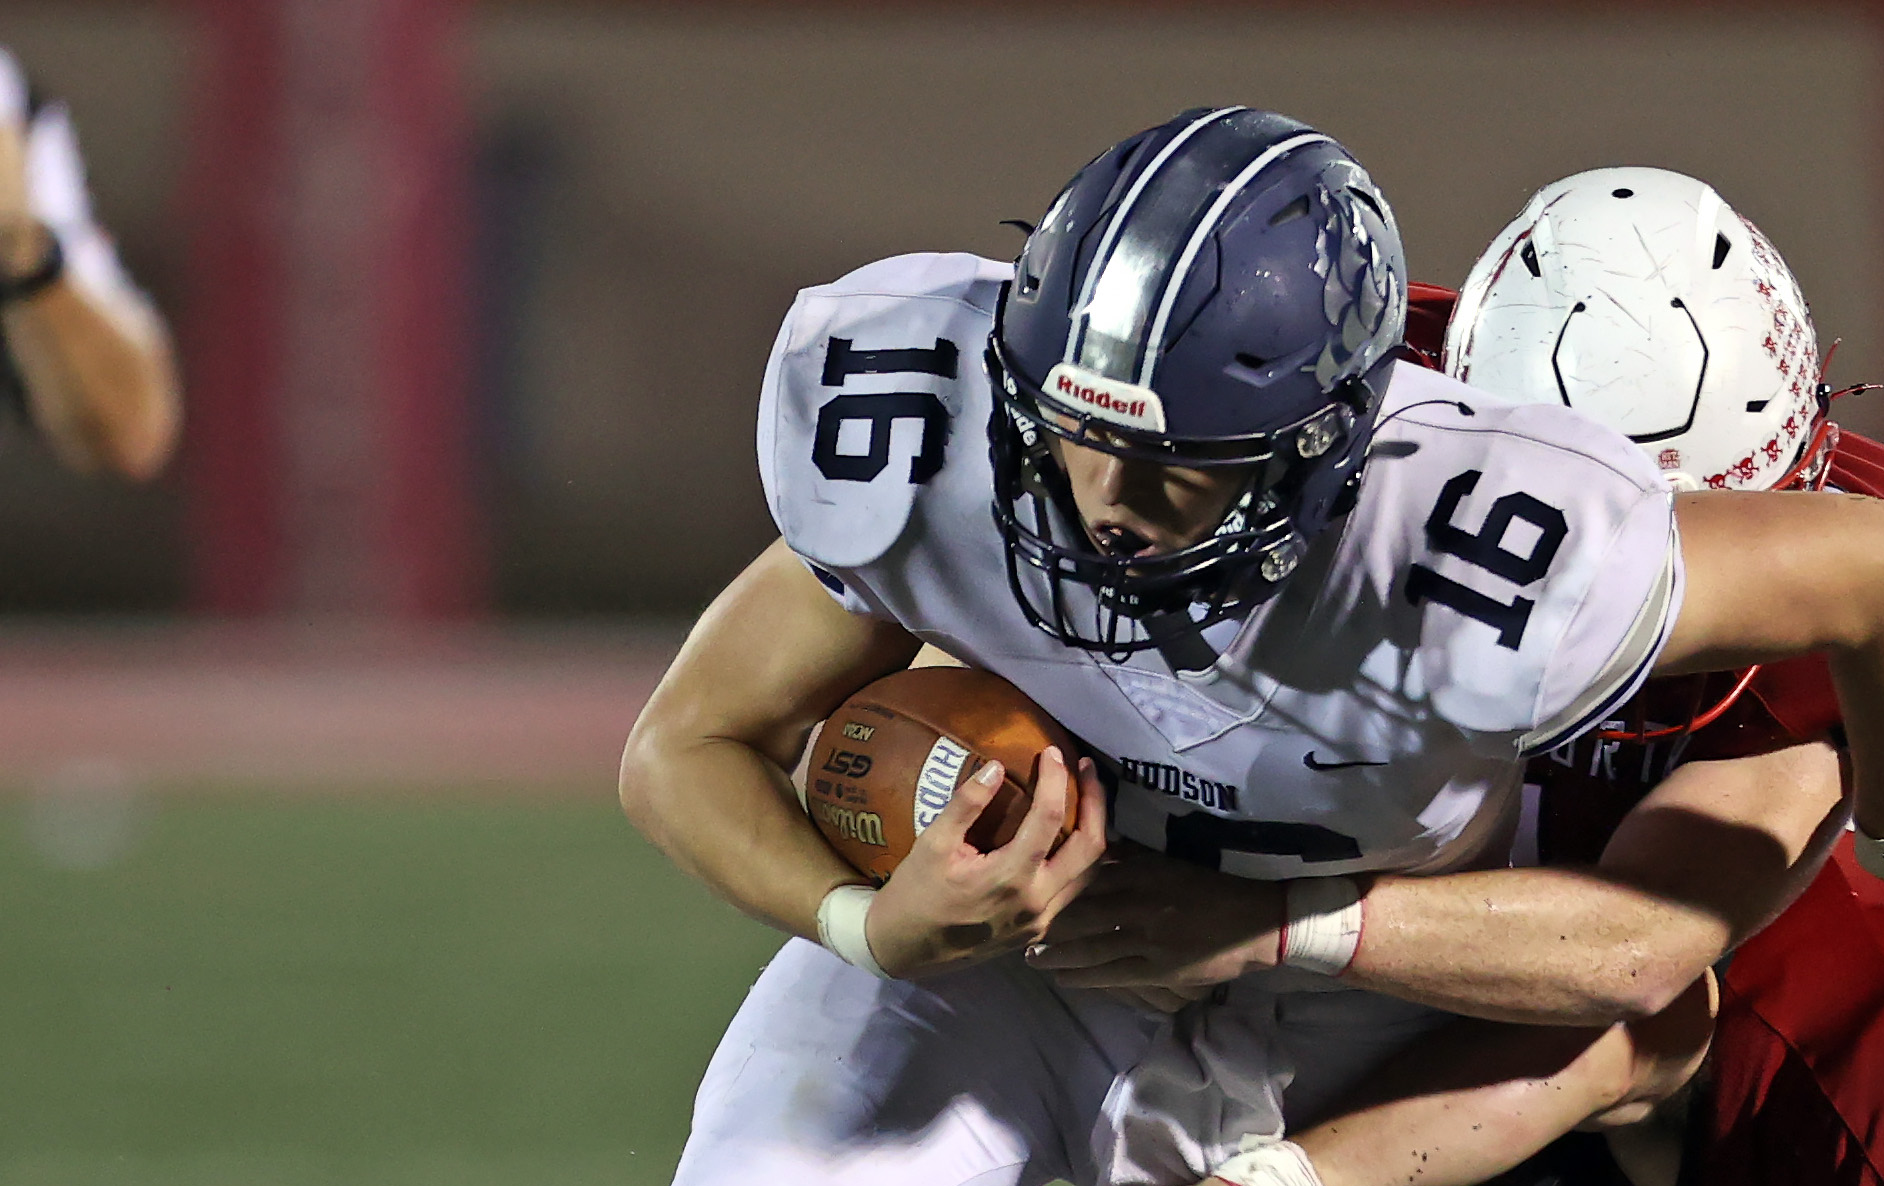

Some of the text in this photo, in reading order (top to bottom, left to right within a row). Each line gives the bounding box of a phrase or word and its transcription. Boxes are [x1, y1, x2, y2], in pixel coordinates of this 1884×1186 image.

[812, 336, 959, 485] 16
[1057, 375, 1147, 418] Riddell
[1404, 469, 1569, 653] 16
[1119, 756, 1238, 812] HUDSON
[813, 799, 888, 848] Wilso
